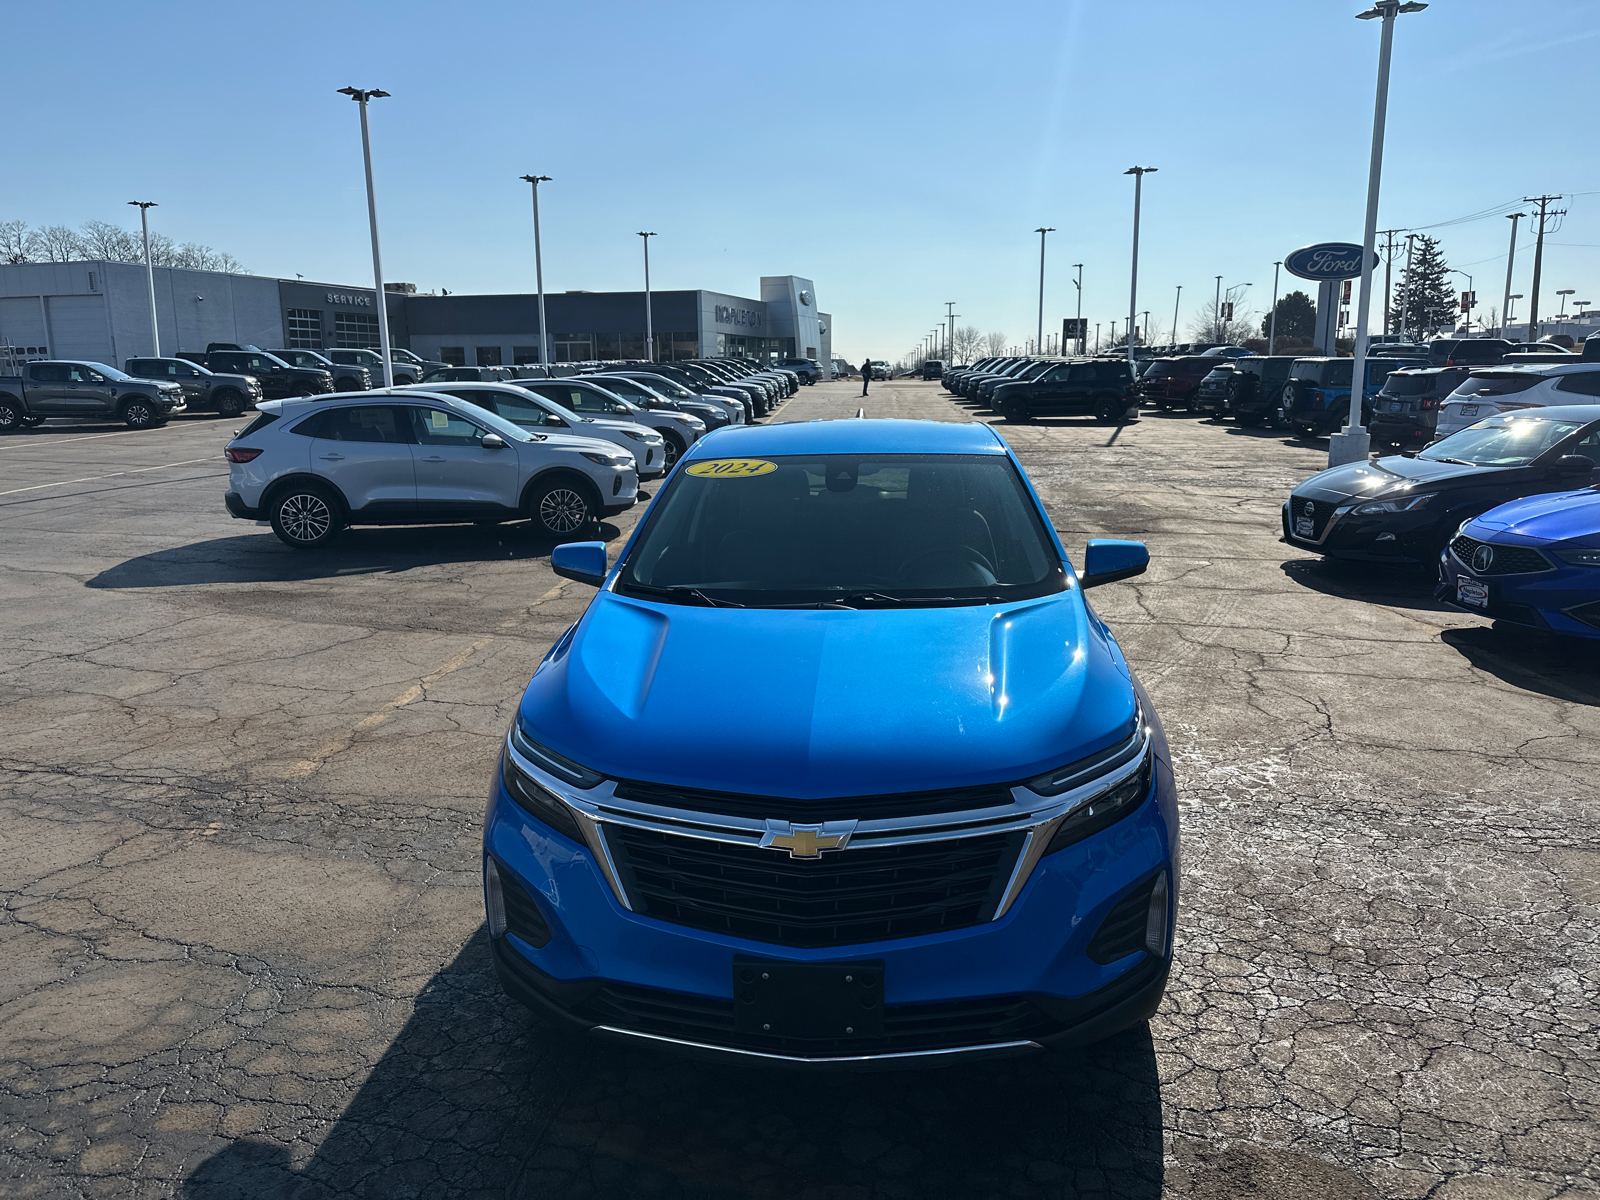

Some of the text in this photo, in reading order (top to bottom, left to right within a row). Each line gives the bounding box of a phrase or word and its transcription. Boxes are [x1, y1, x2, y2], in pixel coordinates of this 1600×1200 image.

[1307, 251, 1361, 272] Ford
[327, 293, 370, 306] SERVICE
[715, 305, 762, 327] NAPLETON
[699, 463, 767, 474] 2024
